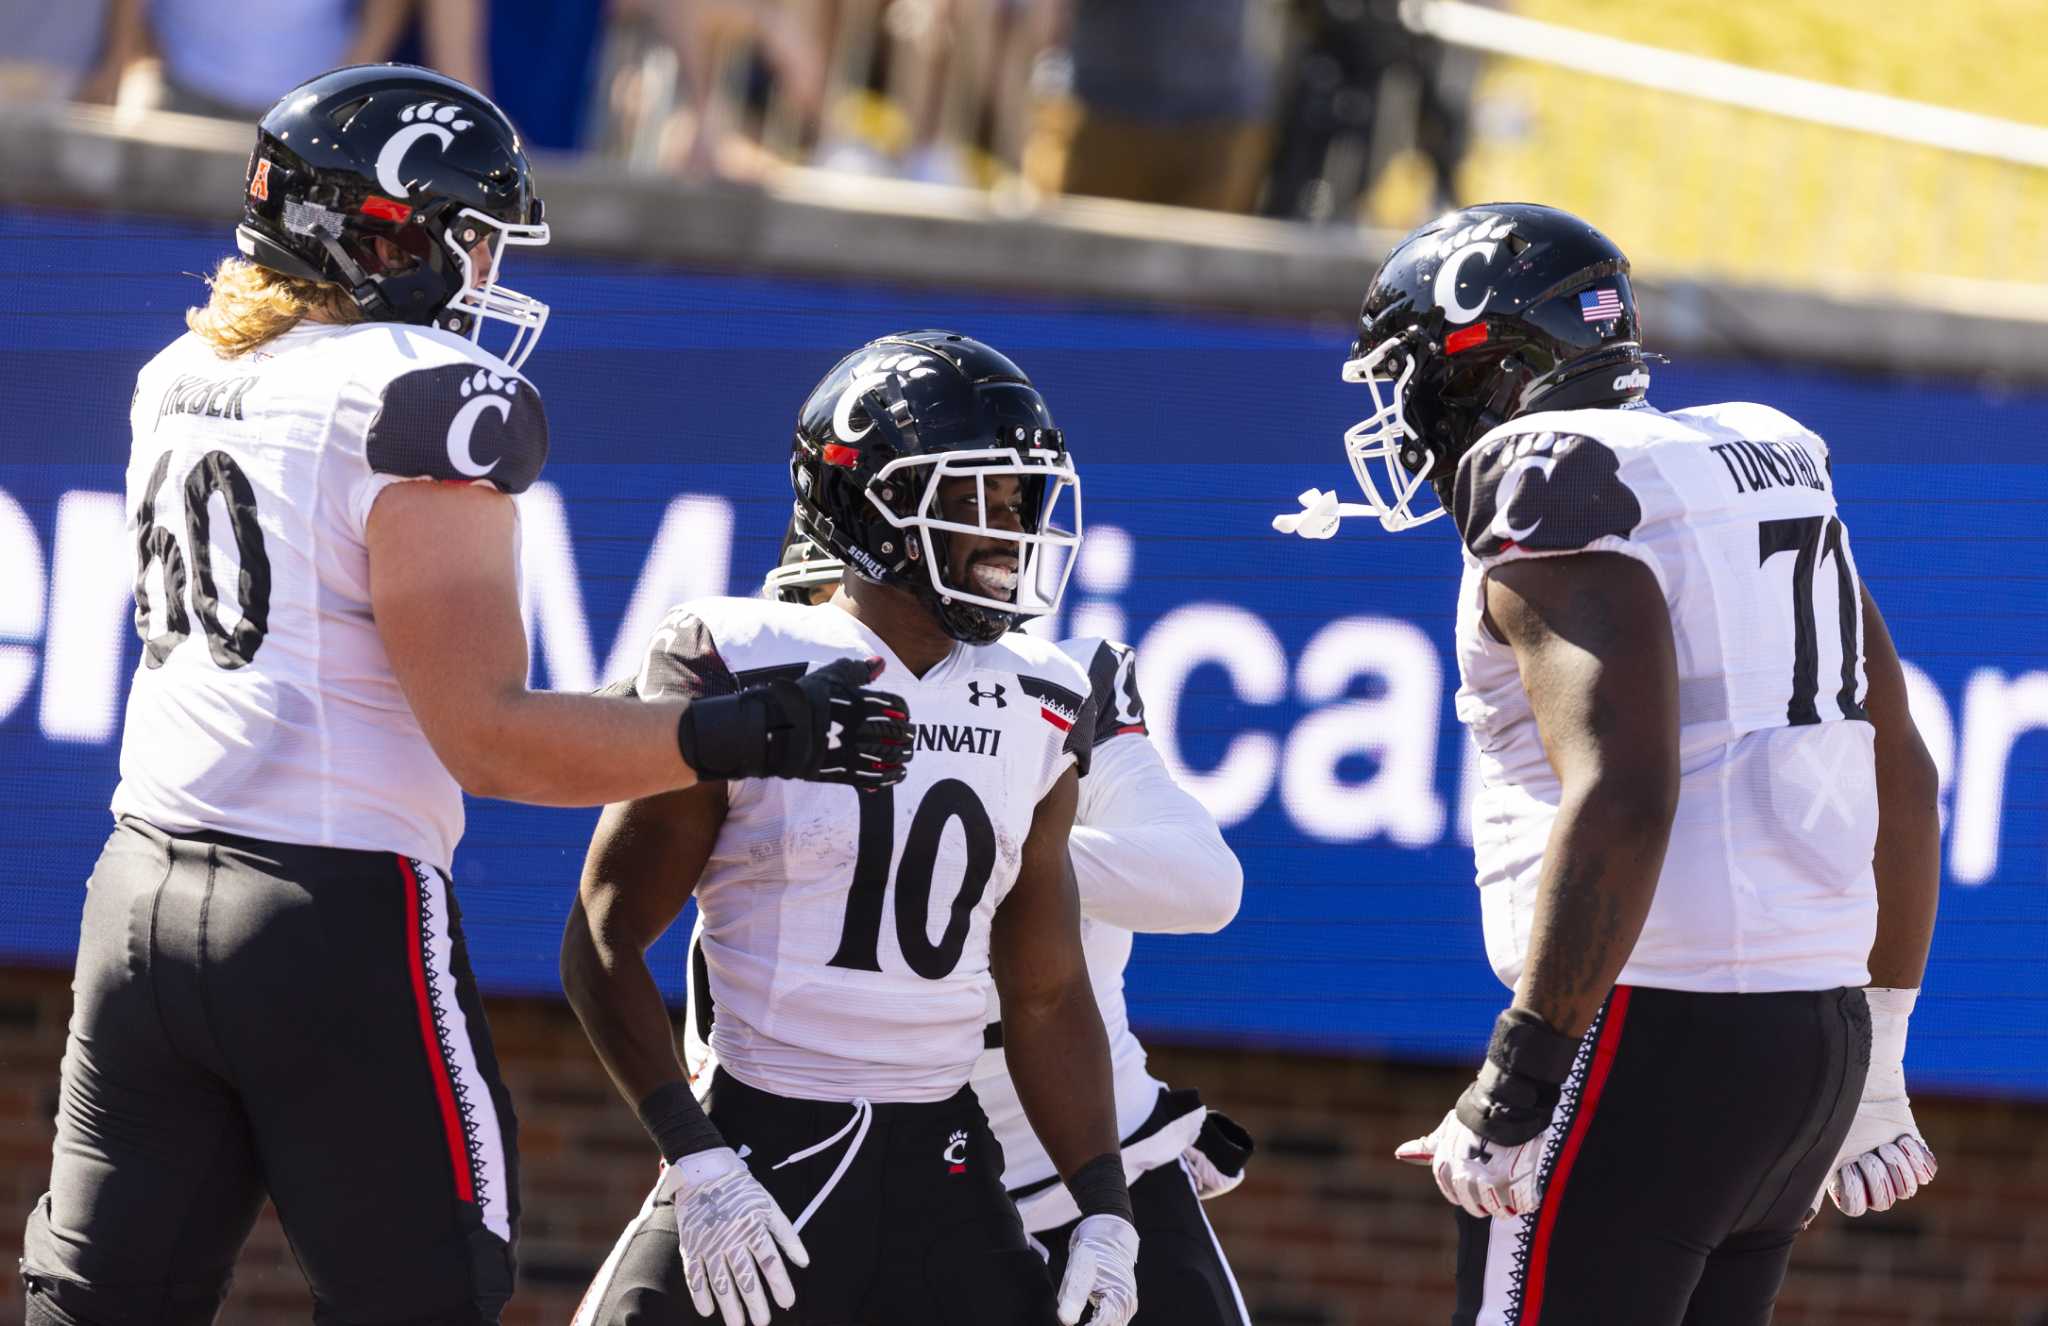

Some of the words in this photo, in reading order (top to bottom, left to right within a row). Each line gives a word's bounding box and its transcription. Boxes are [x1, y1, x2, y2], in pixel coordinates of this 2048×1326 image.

[134, 449, 272, 671] 60
[847, 544, 888, 580] schutt
[825, 778, 997, 980] 10
